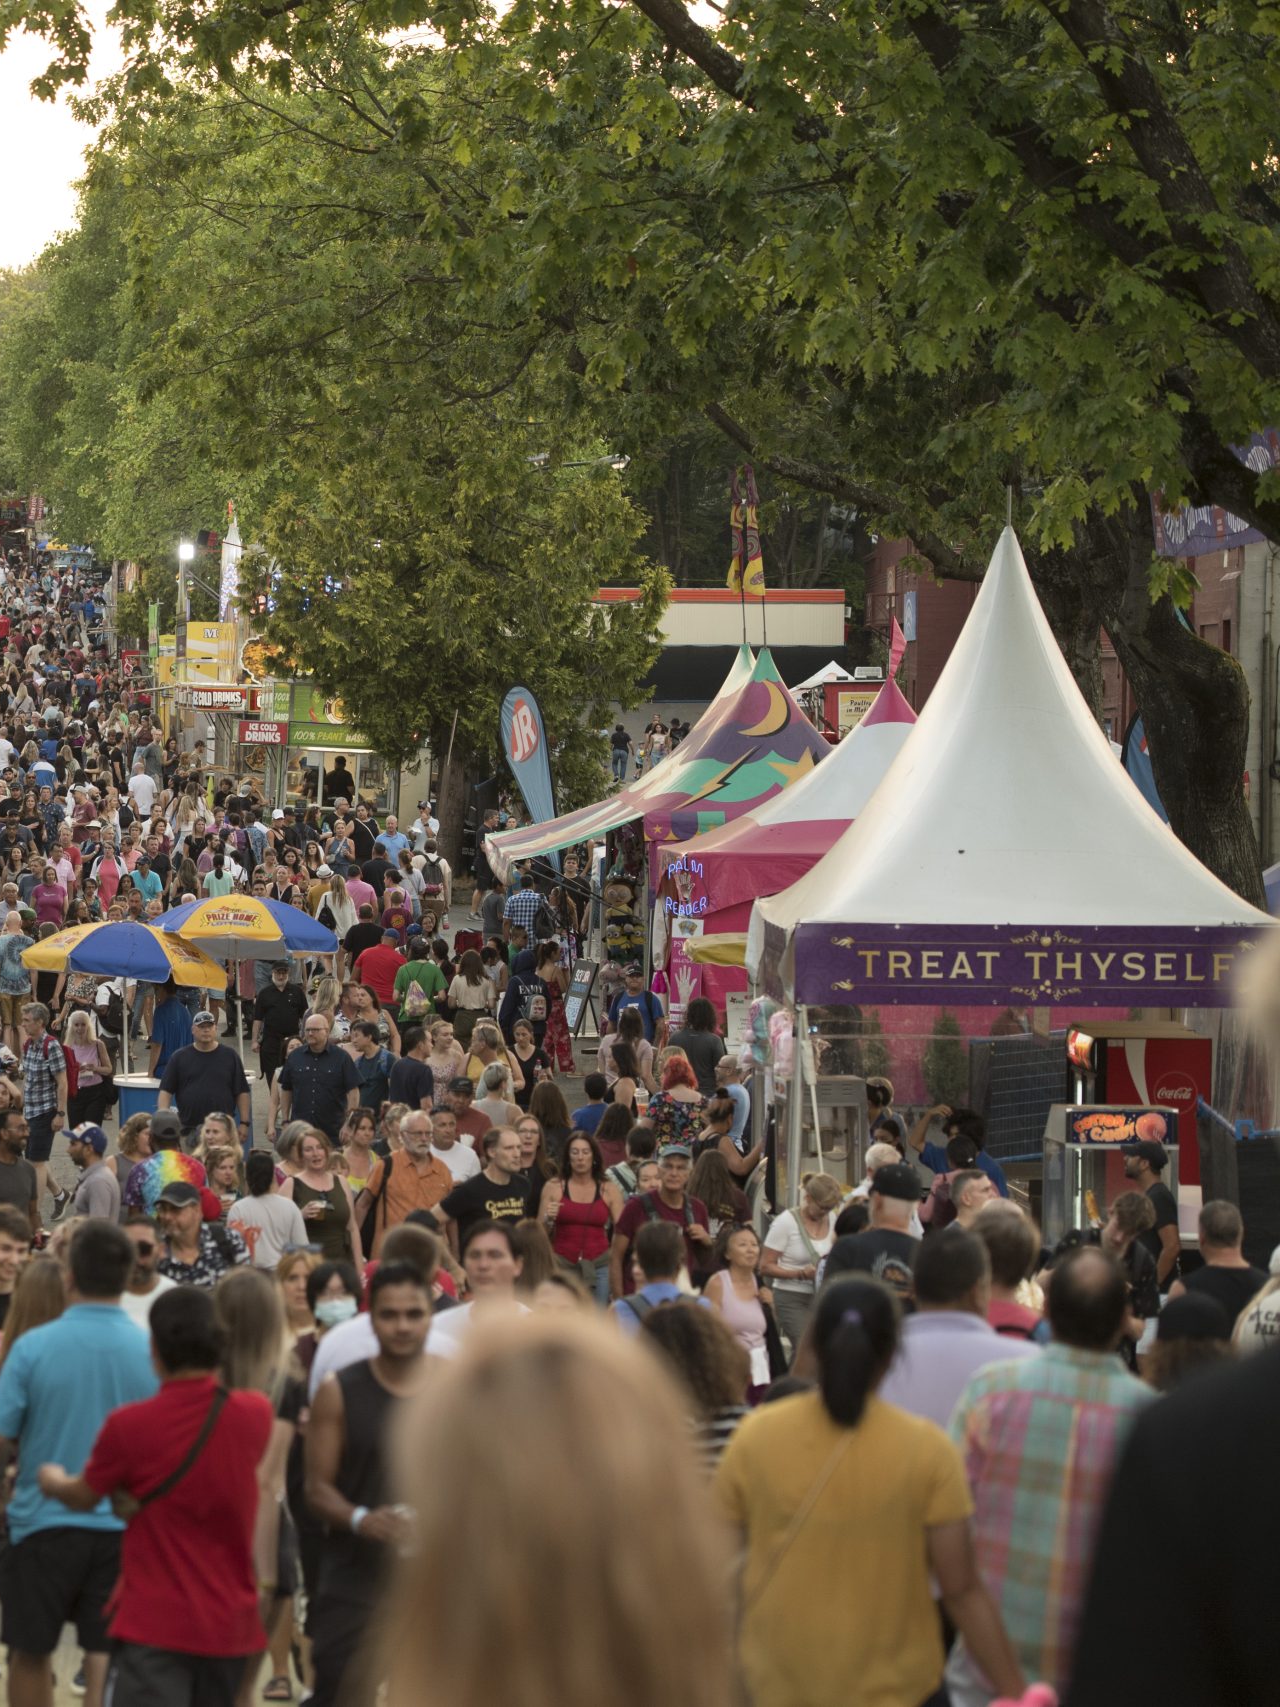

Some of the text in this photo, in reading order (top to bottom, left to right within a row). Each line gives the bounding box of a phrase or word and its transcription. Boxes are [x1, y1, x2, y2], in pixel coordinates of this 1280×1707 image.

[213, 691, 242, 704] DRINKS
[249, 722, 278, 732] ICE COLD
[511, 704, 537, 762] JR
[245, 731, 281, 743] DRINKS
[293, 731, 316, 742] 100%
[317, 731, 345, 742] PLANT
[668, 856, 703, 879] PALM
[665, 897, 707, 916] READER
[206, 913, 258, 922] PRIZE HOME
[858, 950, 1235, 981] TREAT THYSELF
[518, 985, 543, 994] ENJOY
[1073, 1112, 1127, 1133] COTTON
[1090, 1121, 1135, 1142] CANDY
